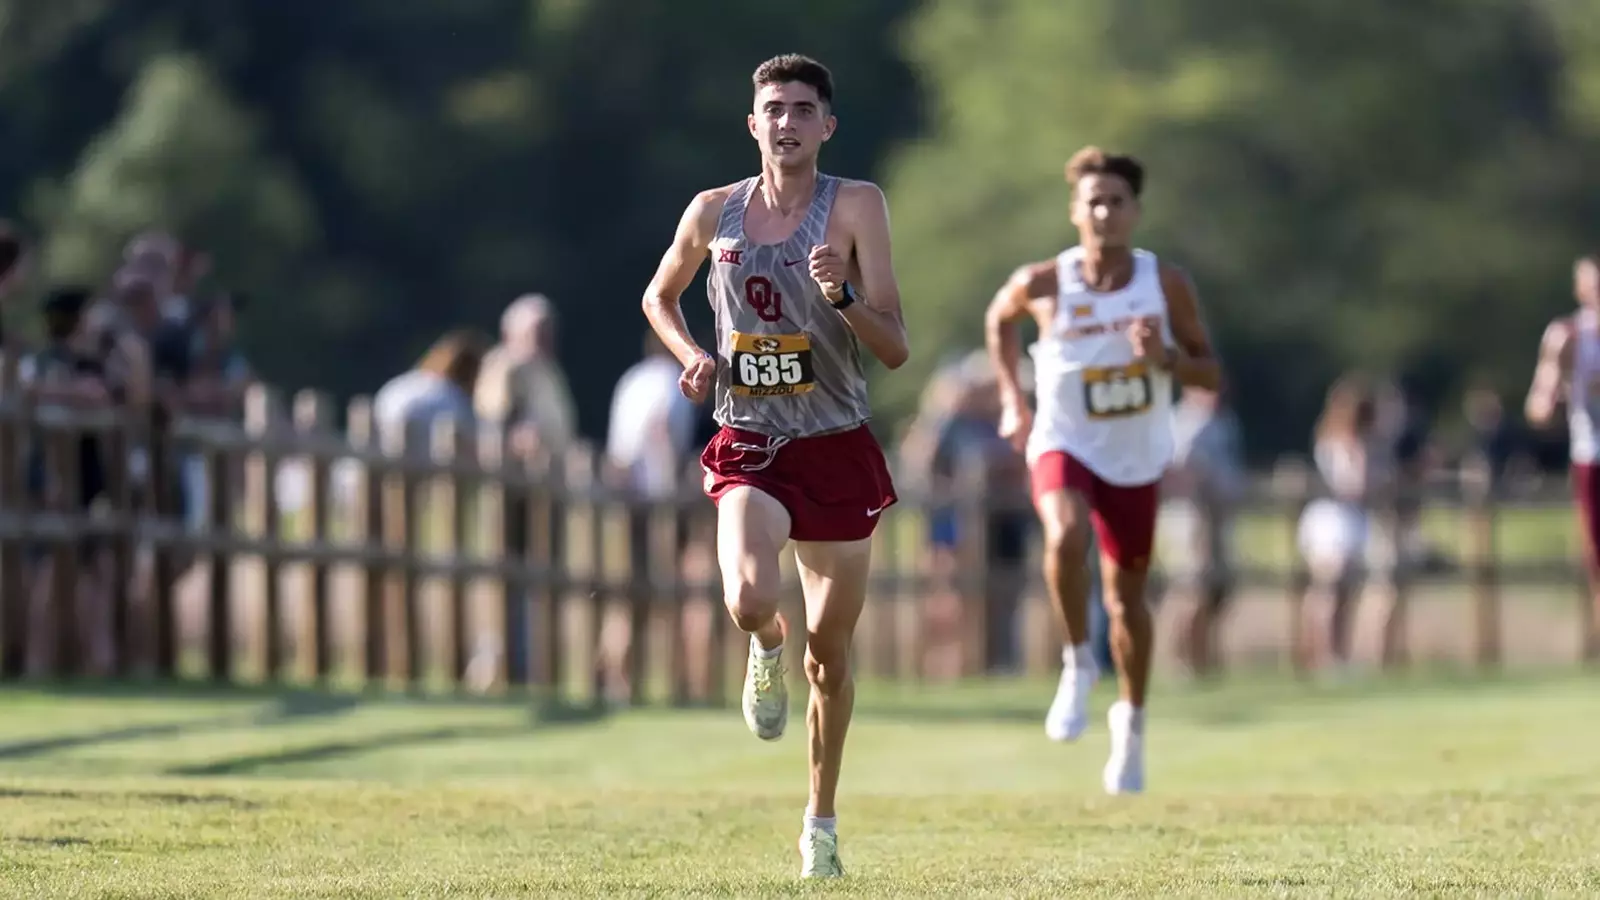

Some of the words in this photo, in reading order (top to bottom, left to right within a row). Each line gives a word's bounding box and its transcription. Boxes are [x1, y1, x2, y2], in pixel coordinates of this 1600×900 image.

[718, 248, 743, 266] XII
[745, 275, 781, 322] OU
[739, 353, 802, 387] 635
[749, 385, 795, 397] MIZZOU
